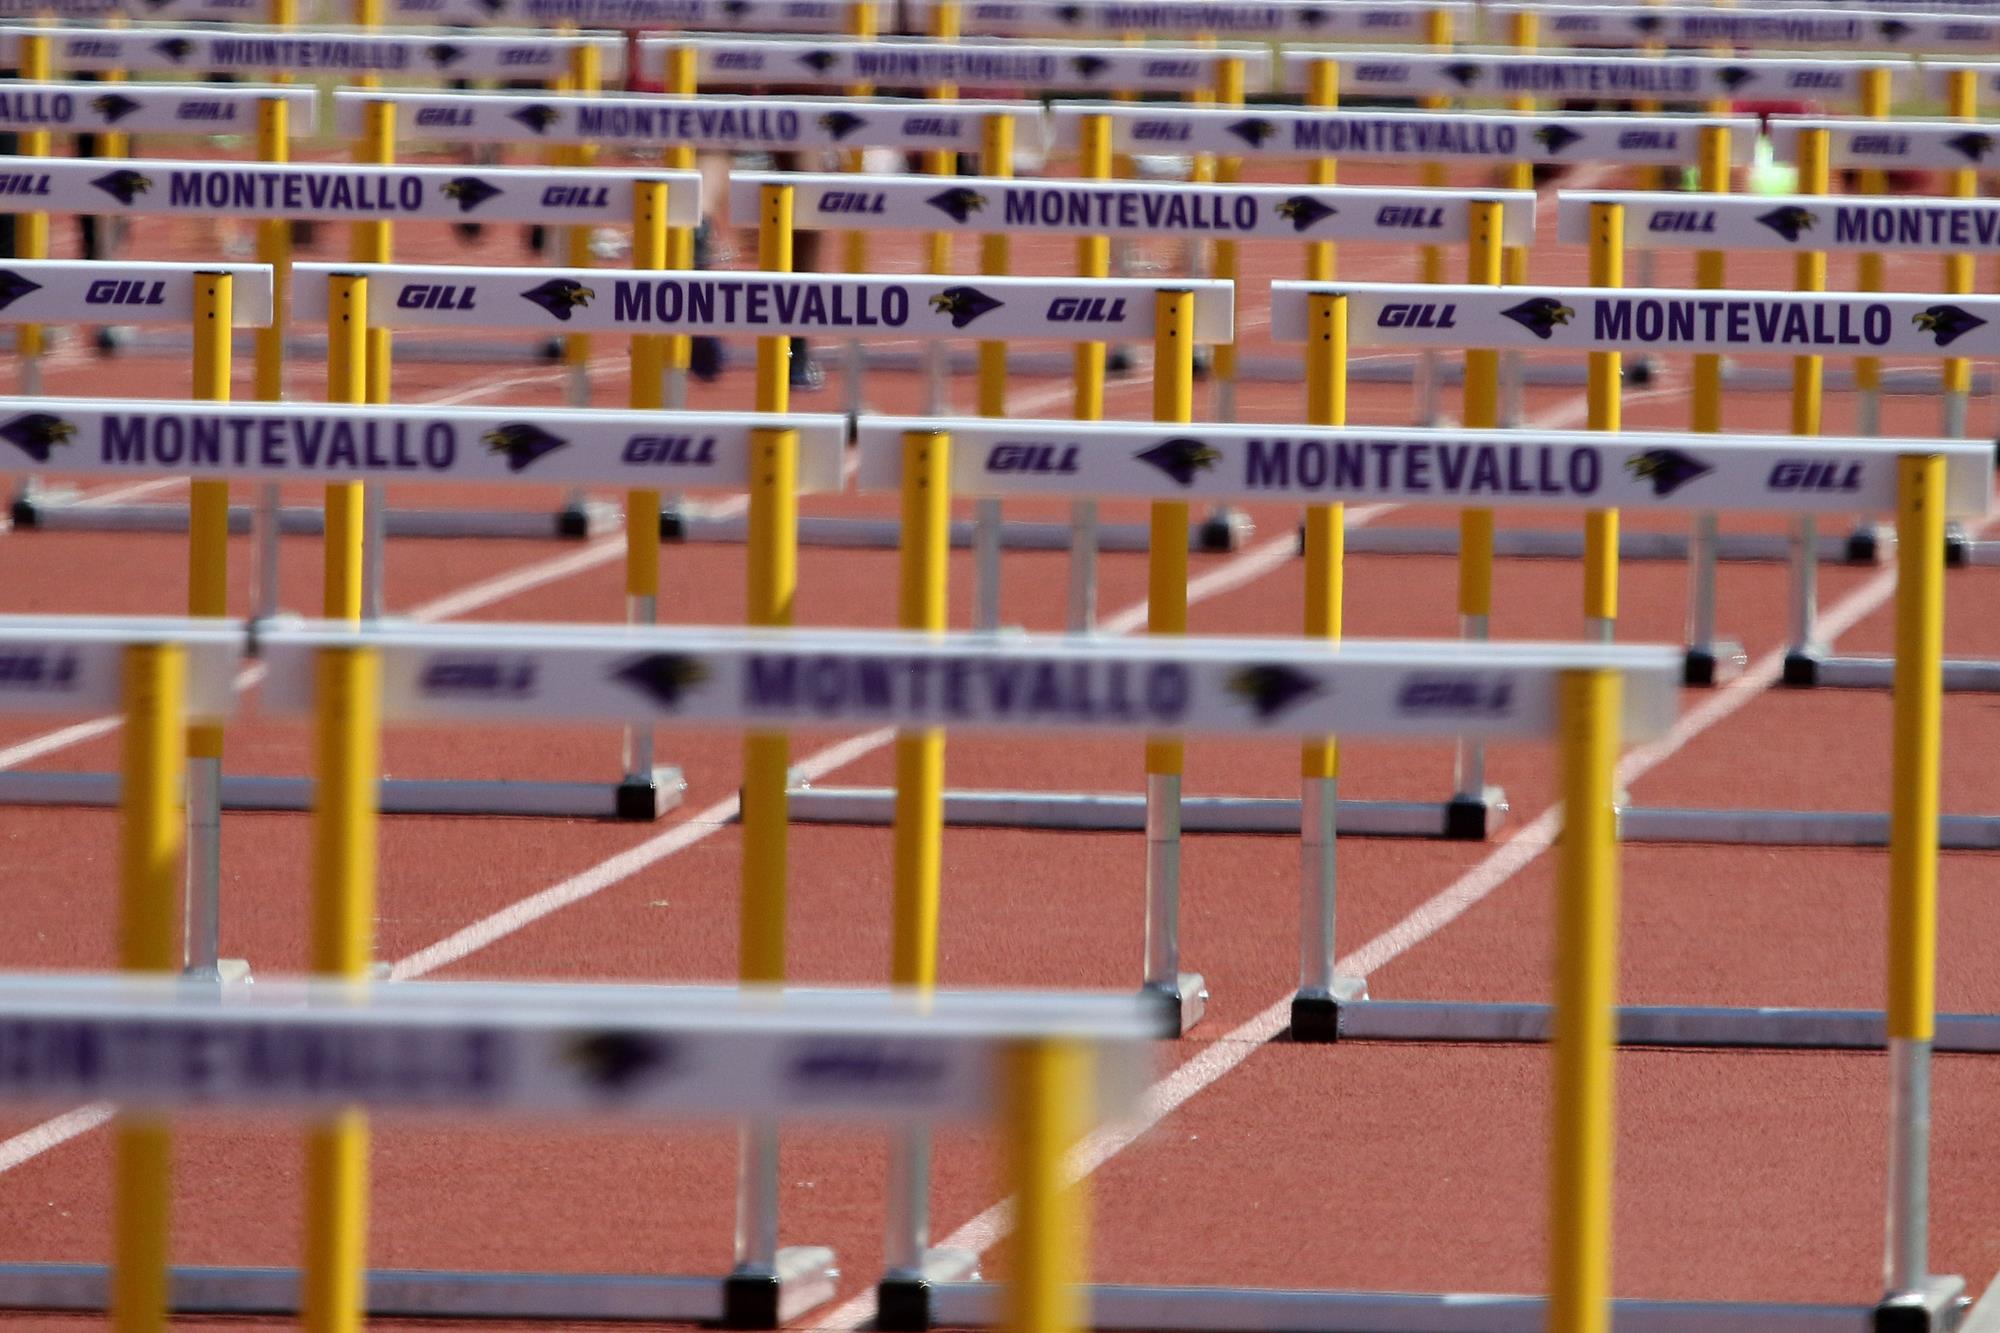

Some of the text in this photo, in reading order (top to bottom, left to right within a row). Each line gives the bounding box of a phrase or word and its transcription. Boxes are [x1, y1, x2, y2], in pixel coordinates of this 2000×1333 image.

[578, 106, 798, 141] MONTEVALLO
[1294, 118, 1517, 154] MONTEVALLO
[168, 171, 424, 212] MONTEVALLO
[541, 186, 609, 207] GILL
[817, 189, 1445, 230] GILL MONTEVALLO GILL
[1648, 206, 2000, 244] GILL MONTEV
[84, 280, 166, 305] GILL
[396, 280, 1127, 326] GILL MONTEVALLO GILL
[1376, 299, 1893, 345] GILL MONTEVALLO
[101, 414, 716, 471] MONTEVALLO GILL
[985, 438, 1866, 496] GILL MONTEVALLO GILL
[740, 655, 1192, 718] MONTEVALLO
